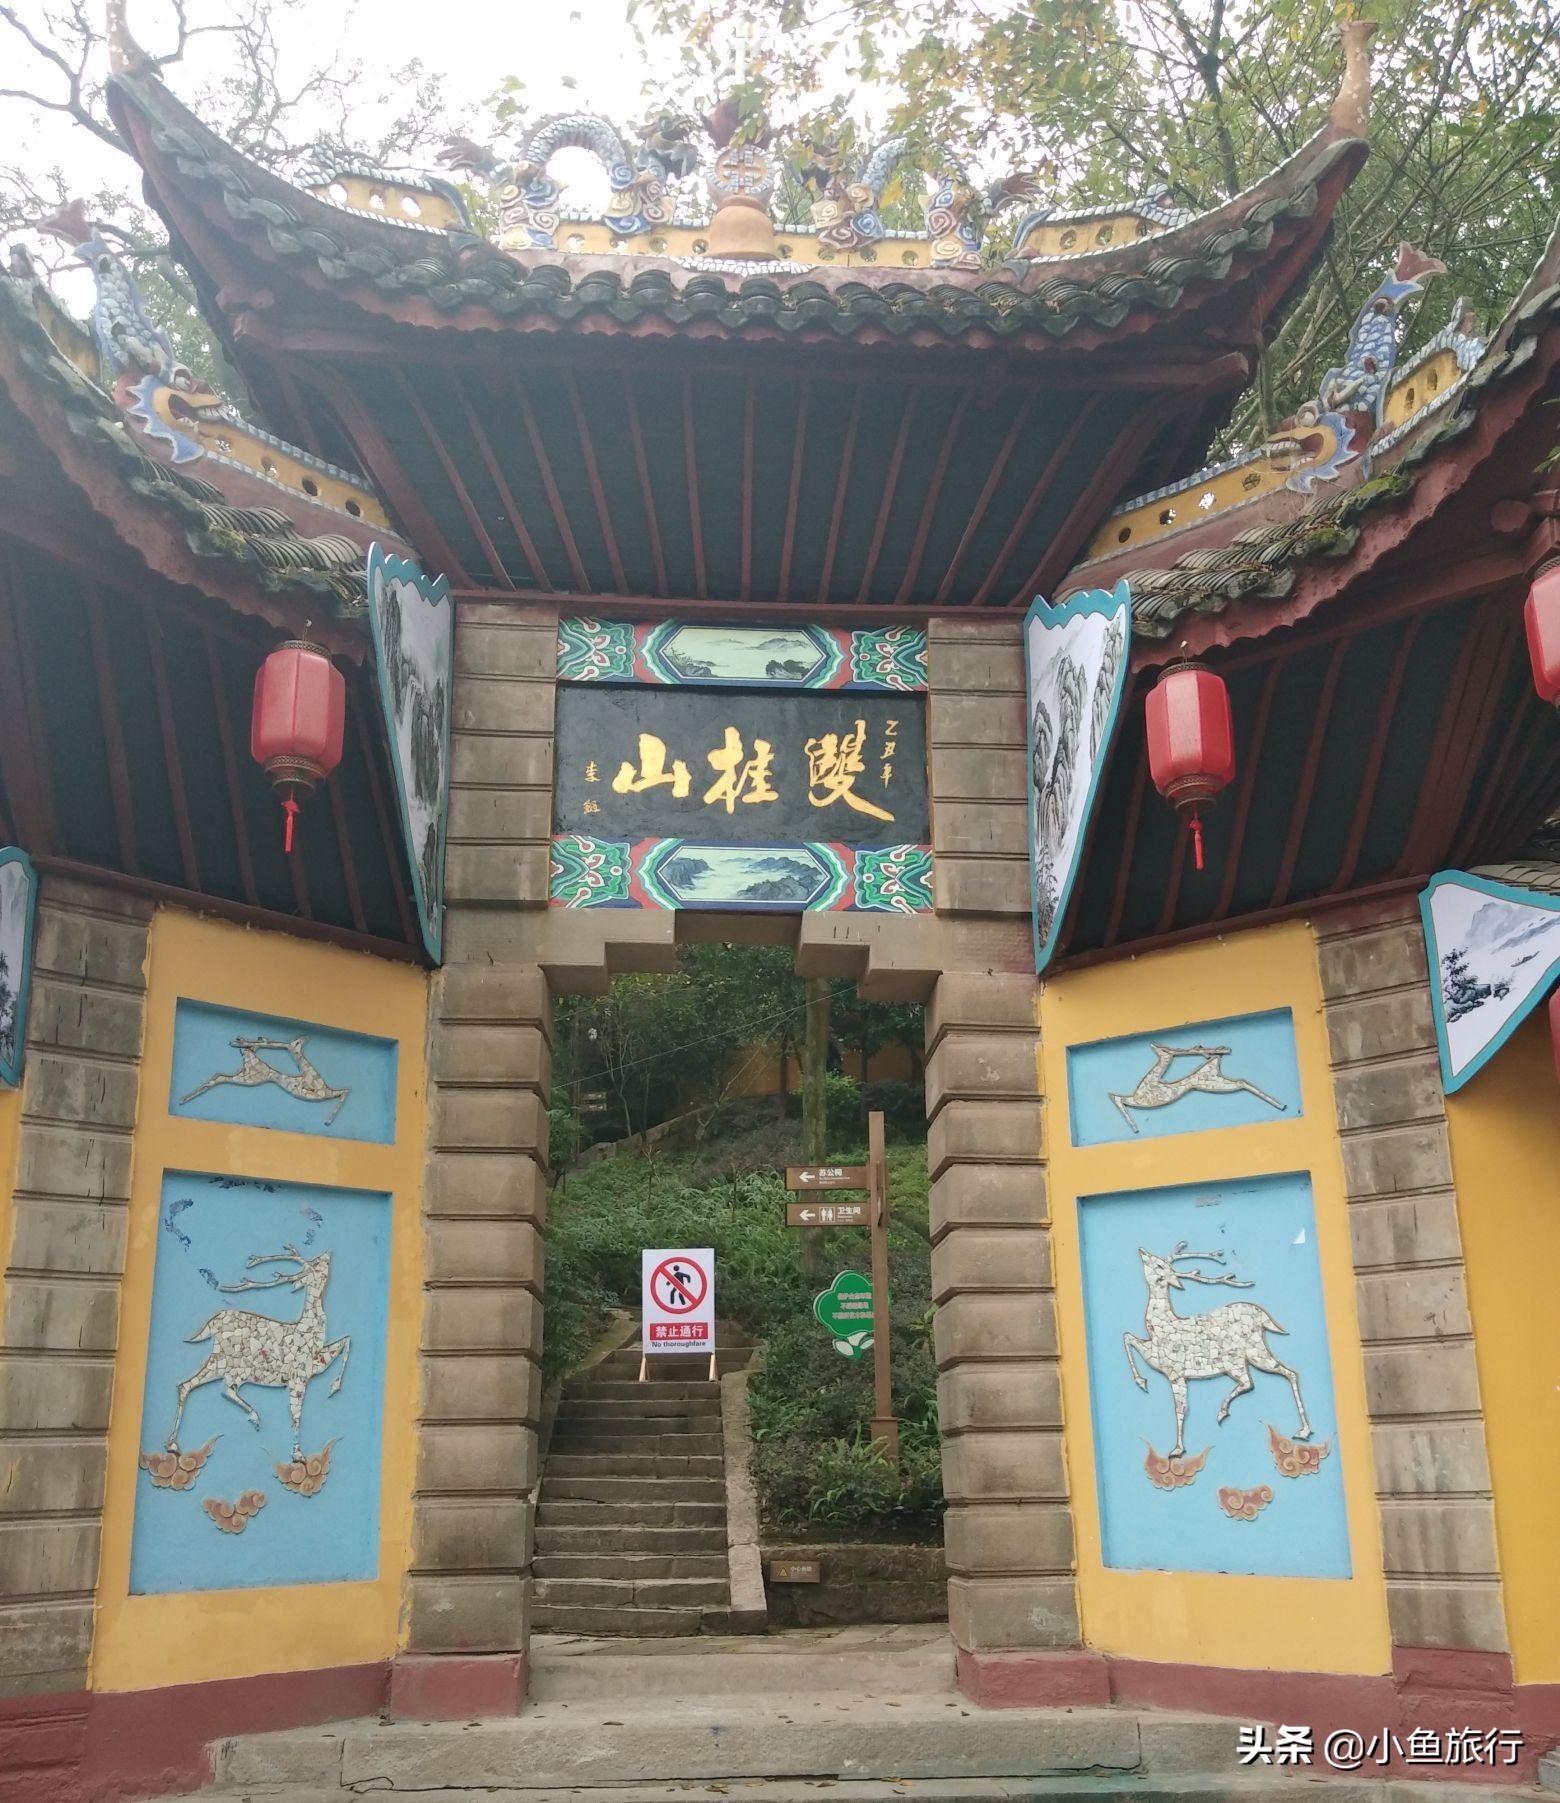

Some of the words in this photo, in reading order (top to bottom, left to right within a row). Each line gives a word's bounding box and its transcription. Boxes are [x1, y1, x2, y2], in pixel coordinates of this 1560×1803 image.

[837, 1206, 861, 1215] 卫生间
[655, 1325, 704, 1338] 禁止通行
[663, 1340, 706, 1349] thoroughfare
